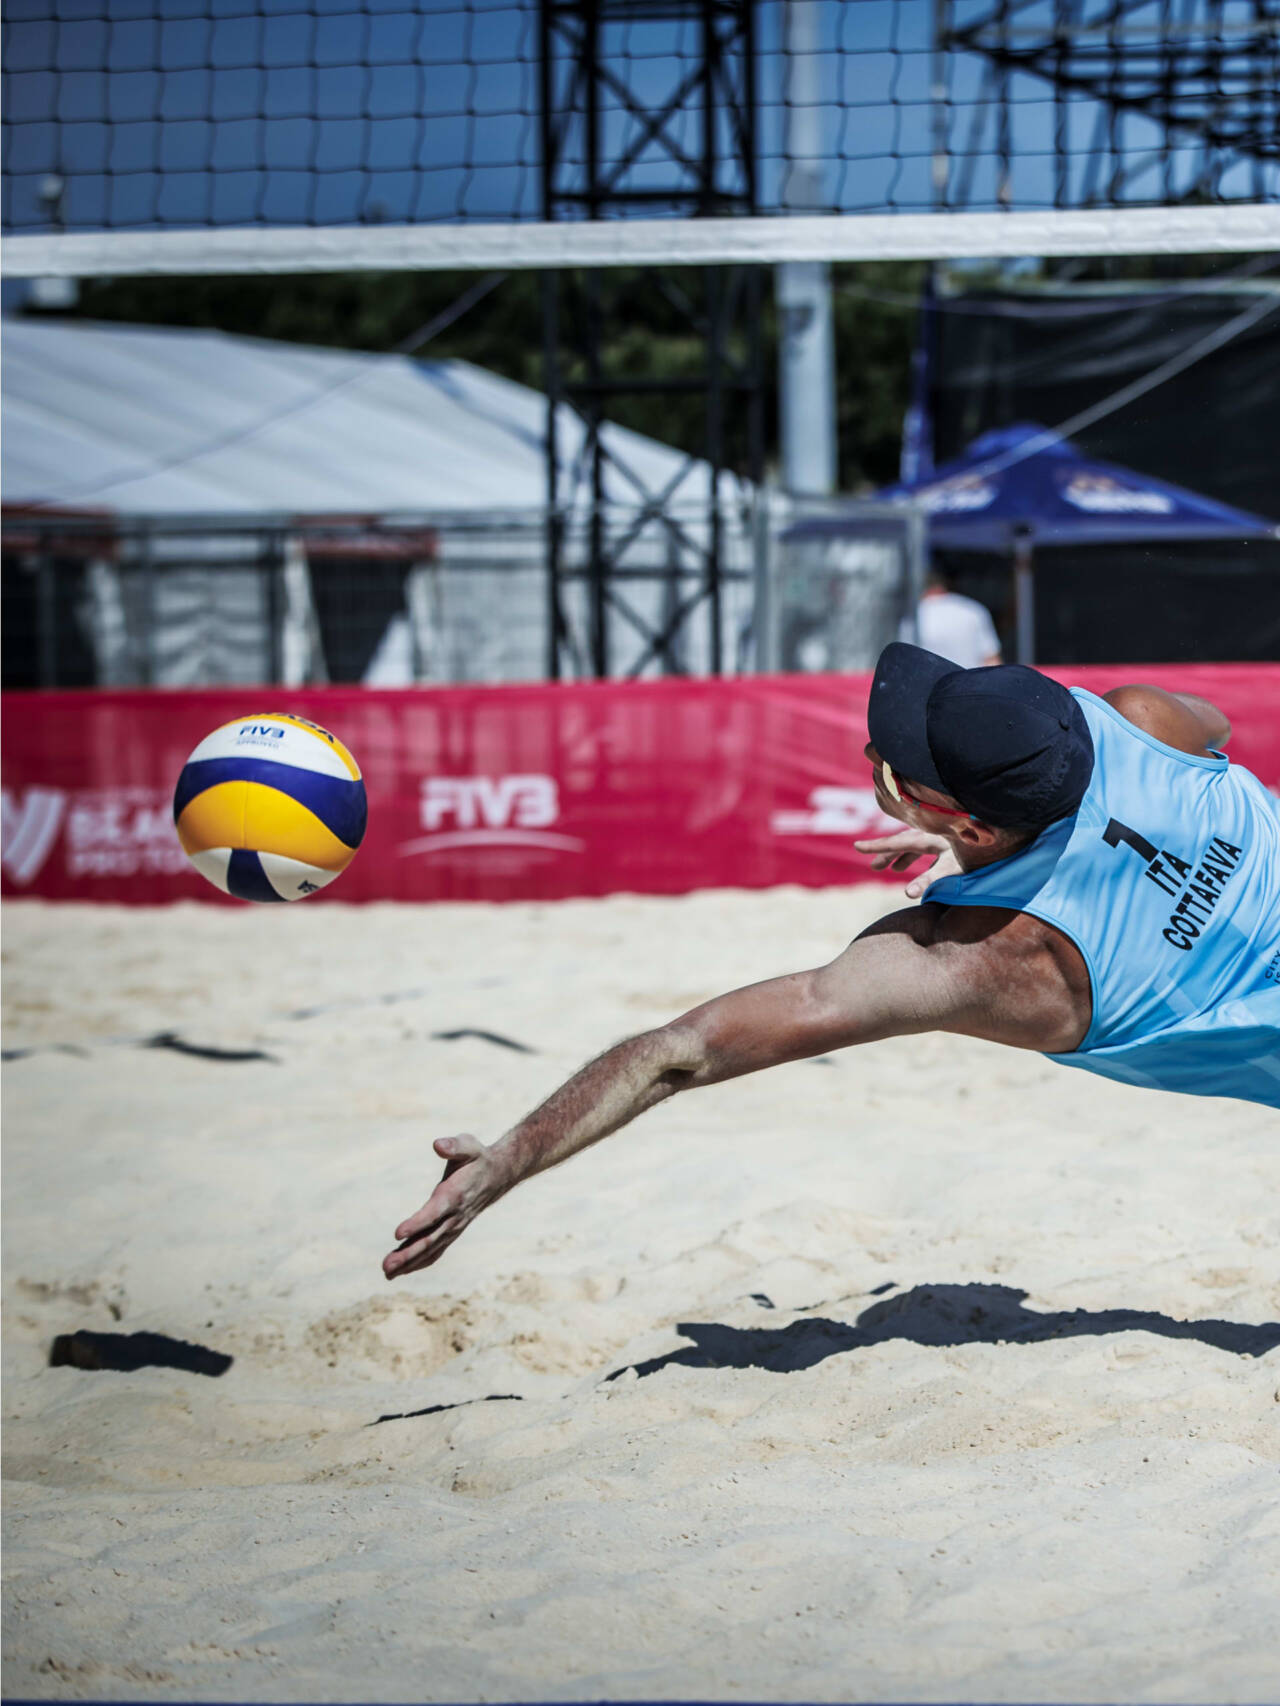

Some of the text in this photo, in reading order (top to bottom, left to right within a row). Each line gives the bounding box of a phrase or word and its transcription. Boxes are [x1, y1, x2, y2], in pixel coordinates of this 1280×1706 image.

[1102, 817, 1161, 862] 1
[1144, 850, 1193, 897] ITA
[1162, 837, 1243, 951] COTTAFAVA
